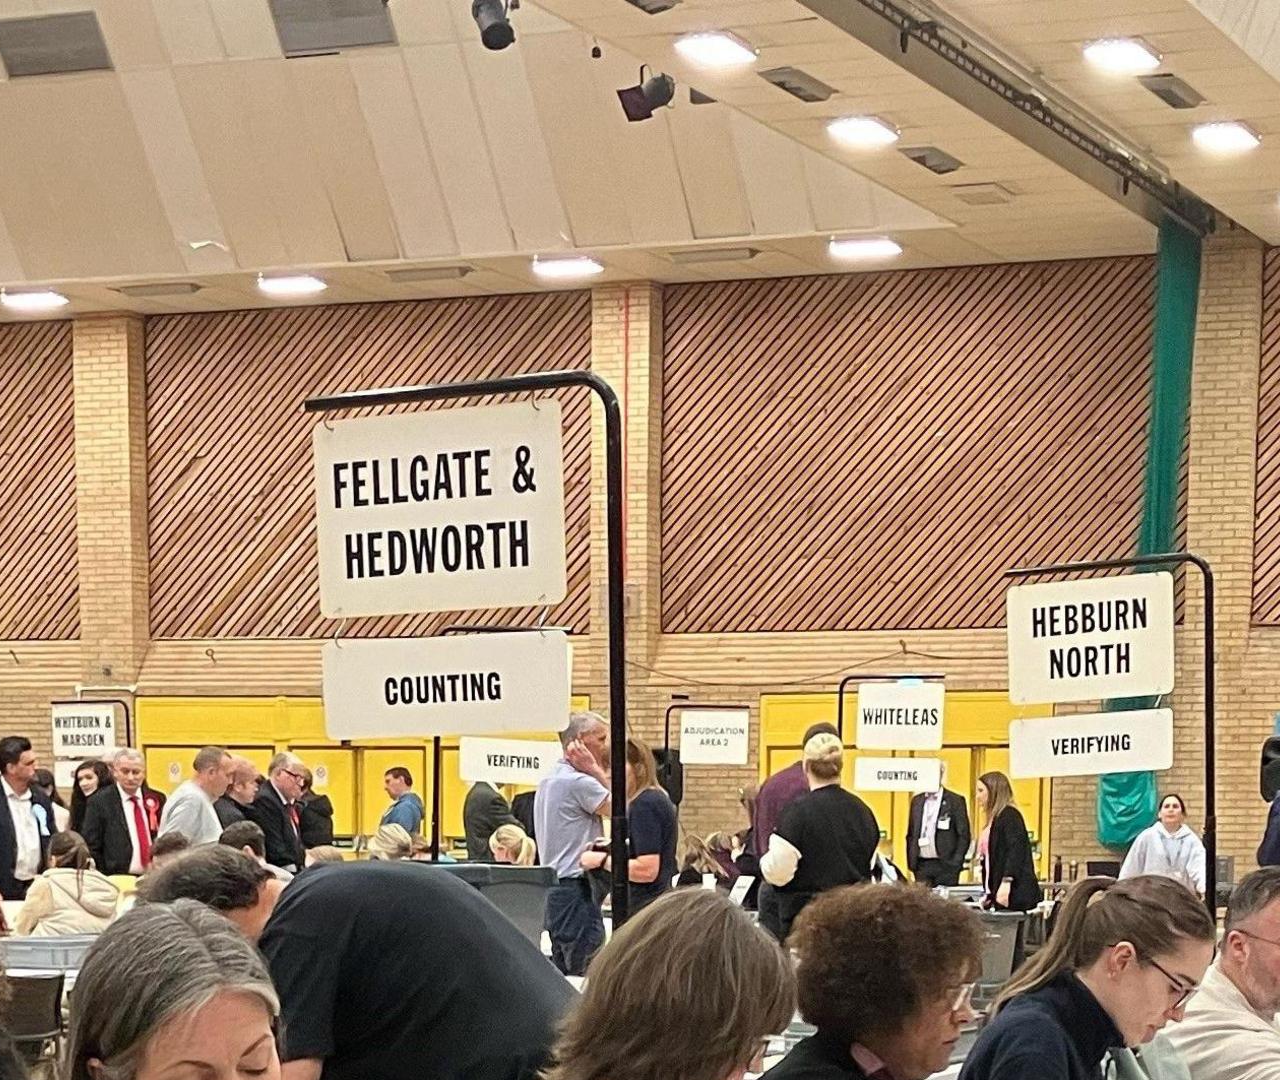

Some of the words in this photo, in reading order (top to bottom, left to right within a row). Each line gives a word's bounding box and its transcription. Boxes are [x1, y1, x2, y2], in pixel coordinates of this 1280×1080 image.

[333, 449, 492, 508] FELLGATE
[512, 445, 537, 494] &
[345, 520, 530, 579] HEDWORTH
[1032, 598, 1147, 638] HEBBURN
[1049, 643, 1130, 679] NORTH
[384, 672, 501, 706] COUNTING
[54, 716, 100, 729] WHITBURN
[105, 715, 111, 728] &
[863, 708, 939, 726] WHITELEAS
[62, 734, 105, 746] MARSDEN
[684, 727, 745, 735] ADJUDICATION
[1052, 734, 1131, 755] VERIFYING
[487, 754, 539, 769] VERIFYING
[877, 771, 918, 781] COUNTING
